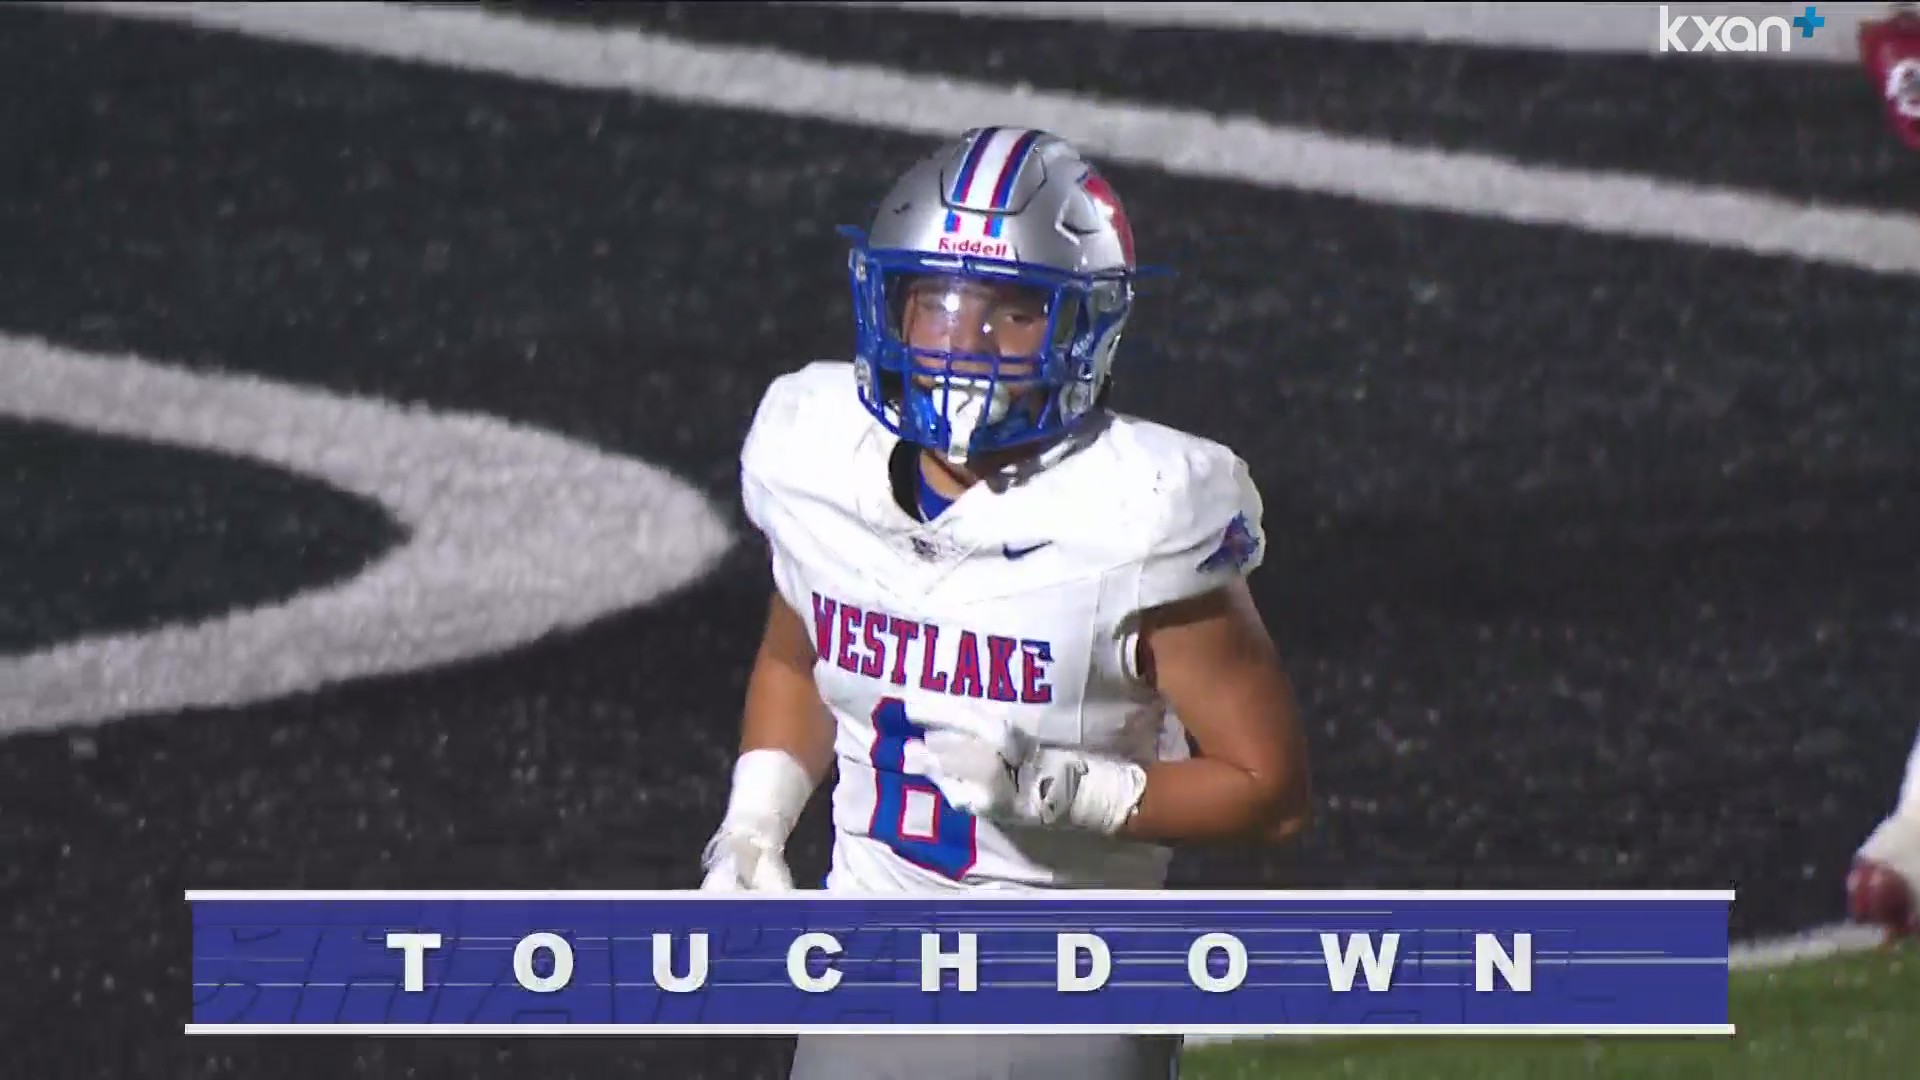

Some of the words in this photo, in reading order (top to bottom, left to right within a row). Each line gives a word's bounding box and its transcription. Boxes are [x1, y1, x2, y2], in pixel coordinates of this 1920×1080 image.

[938, 236, 1008, 257] Riddell
[811, 590, 1053, 704] WESTLAKE
[868, 696, 977, 882] 6
